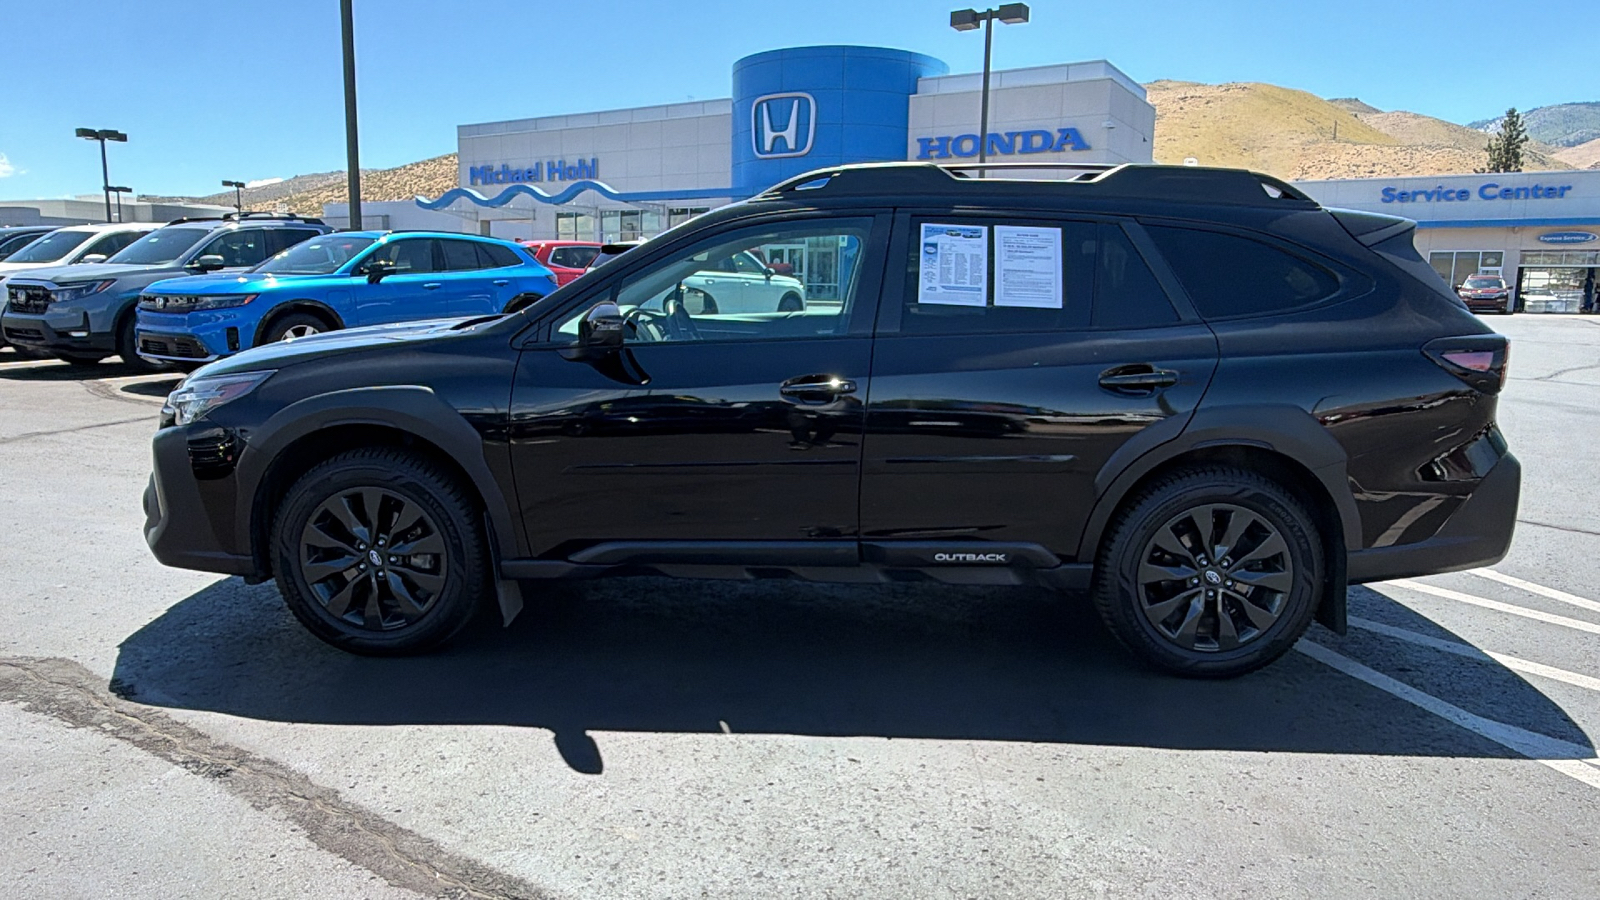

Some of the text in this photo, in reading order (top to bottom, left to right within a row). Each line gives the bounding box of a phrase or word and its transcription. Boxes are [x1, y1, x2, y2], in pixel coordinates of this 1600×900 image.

[917, 127, 1092, 160] HONDA
[469, 157, 599, 186] Michael Hohl
[1381, 182, 1573, 204] Service Center
[934, 552, 1006, 561] OUTBACK
